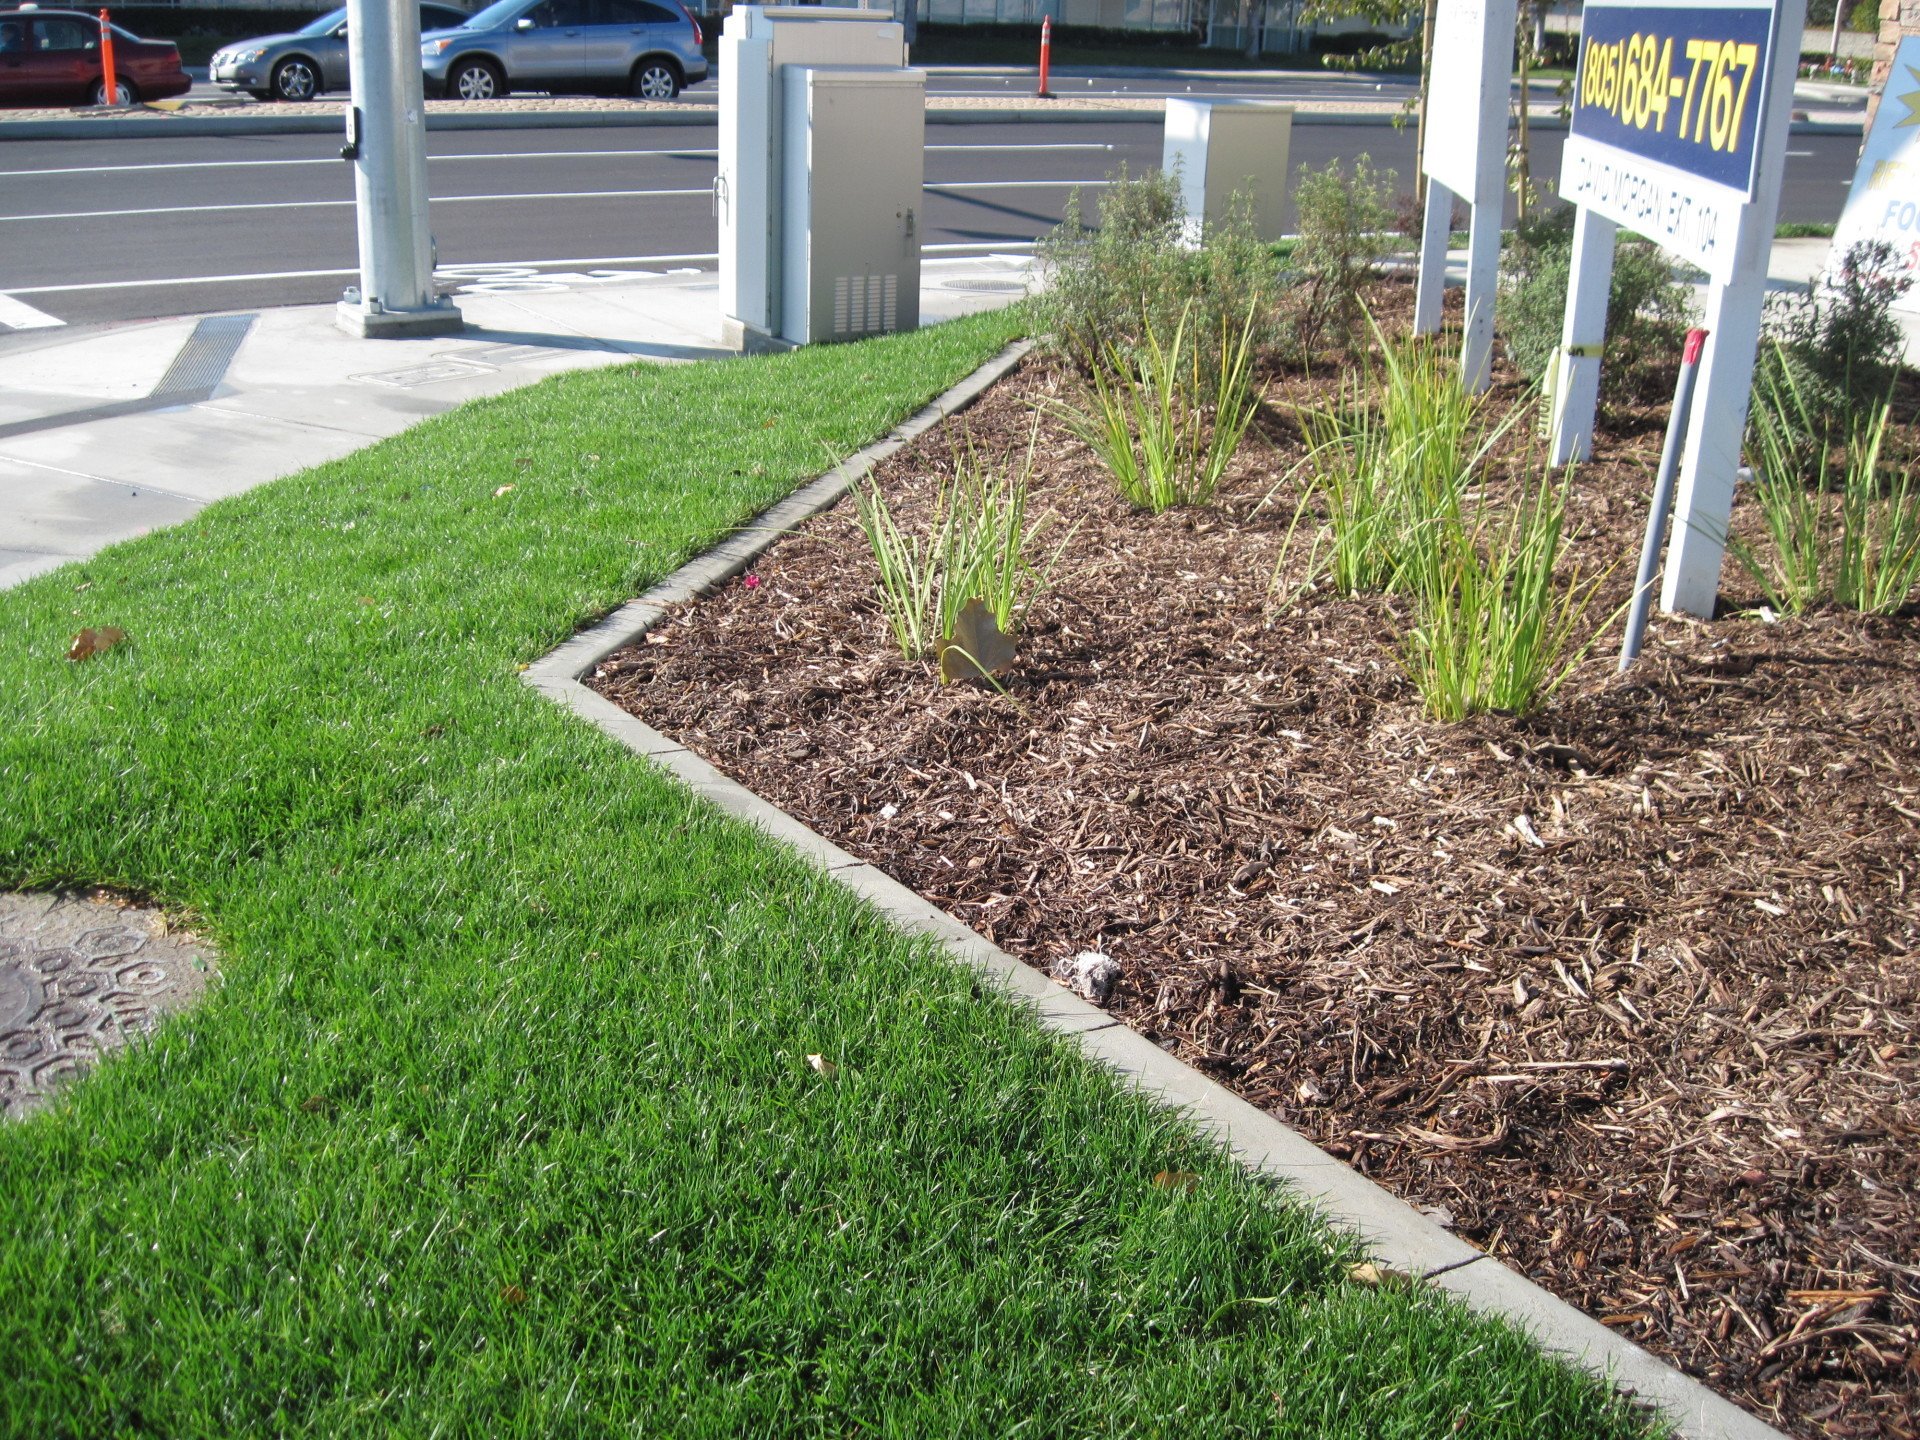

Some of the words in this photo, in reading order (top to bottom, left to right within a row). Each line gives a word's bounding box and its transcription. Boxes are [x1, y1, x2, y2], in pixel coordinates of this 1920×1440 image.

[1577, 156, 1610, 202] DAVID
[1614, 169, 1661, 227] MORGAN
[1696, 206, 1718, 256] 104
